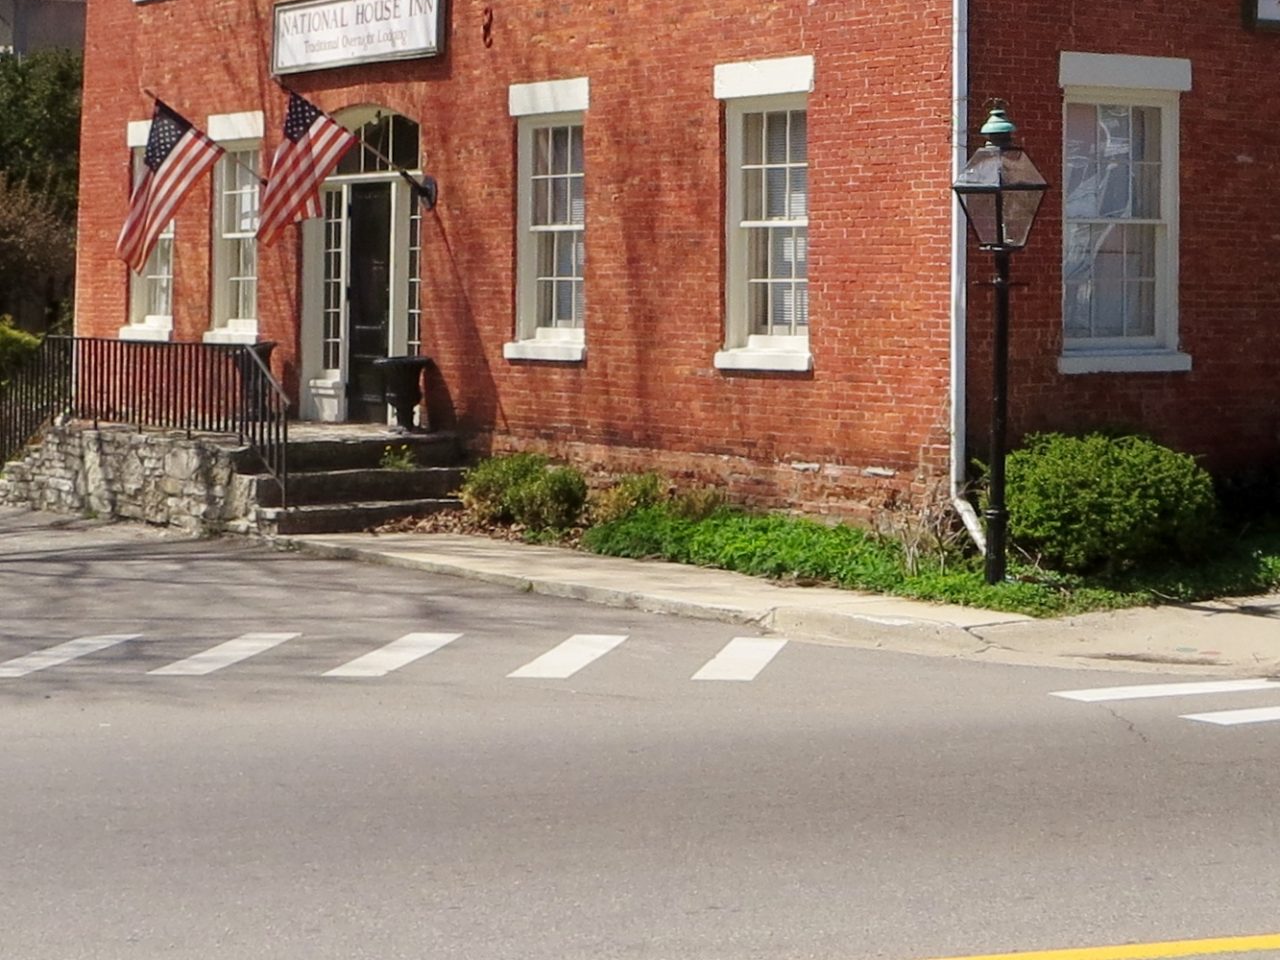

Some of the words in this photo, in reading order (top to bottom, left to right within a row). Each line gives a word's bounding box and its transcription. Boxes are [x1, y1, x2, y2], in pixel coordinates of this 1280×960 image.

[281, 7, 348, 37] NATIONAL
[342, 33, 375, 50] Overnight
[377, 29, 408, 46] Lodging
